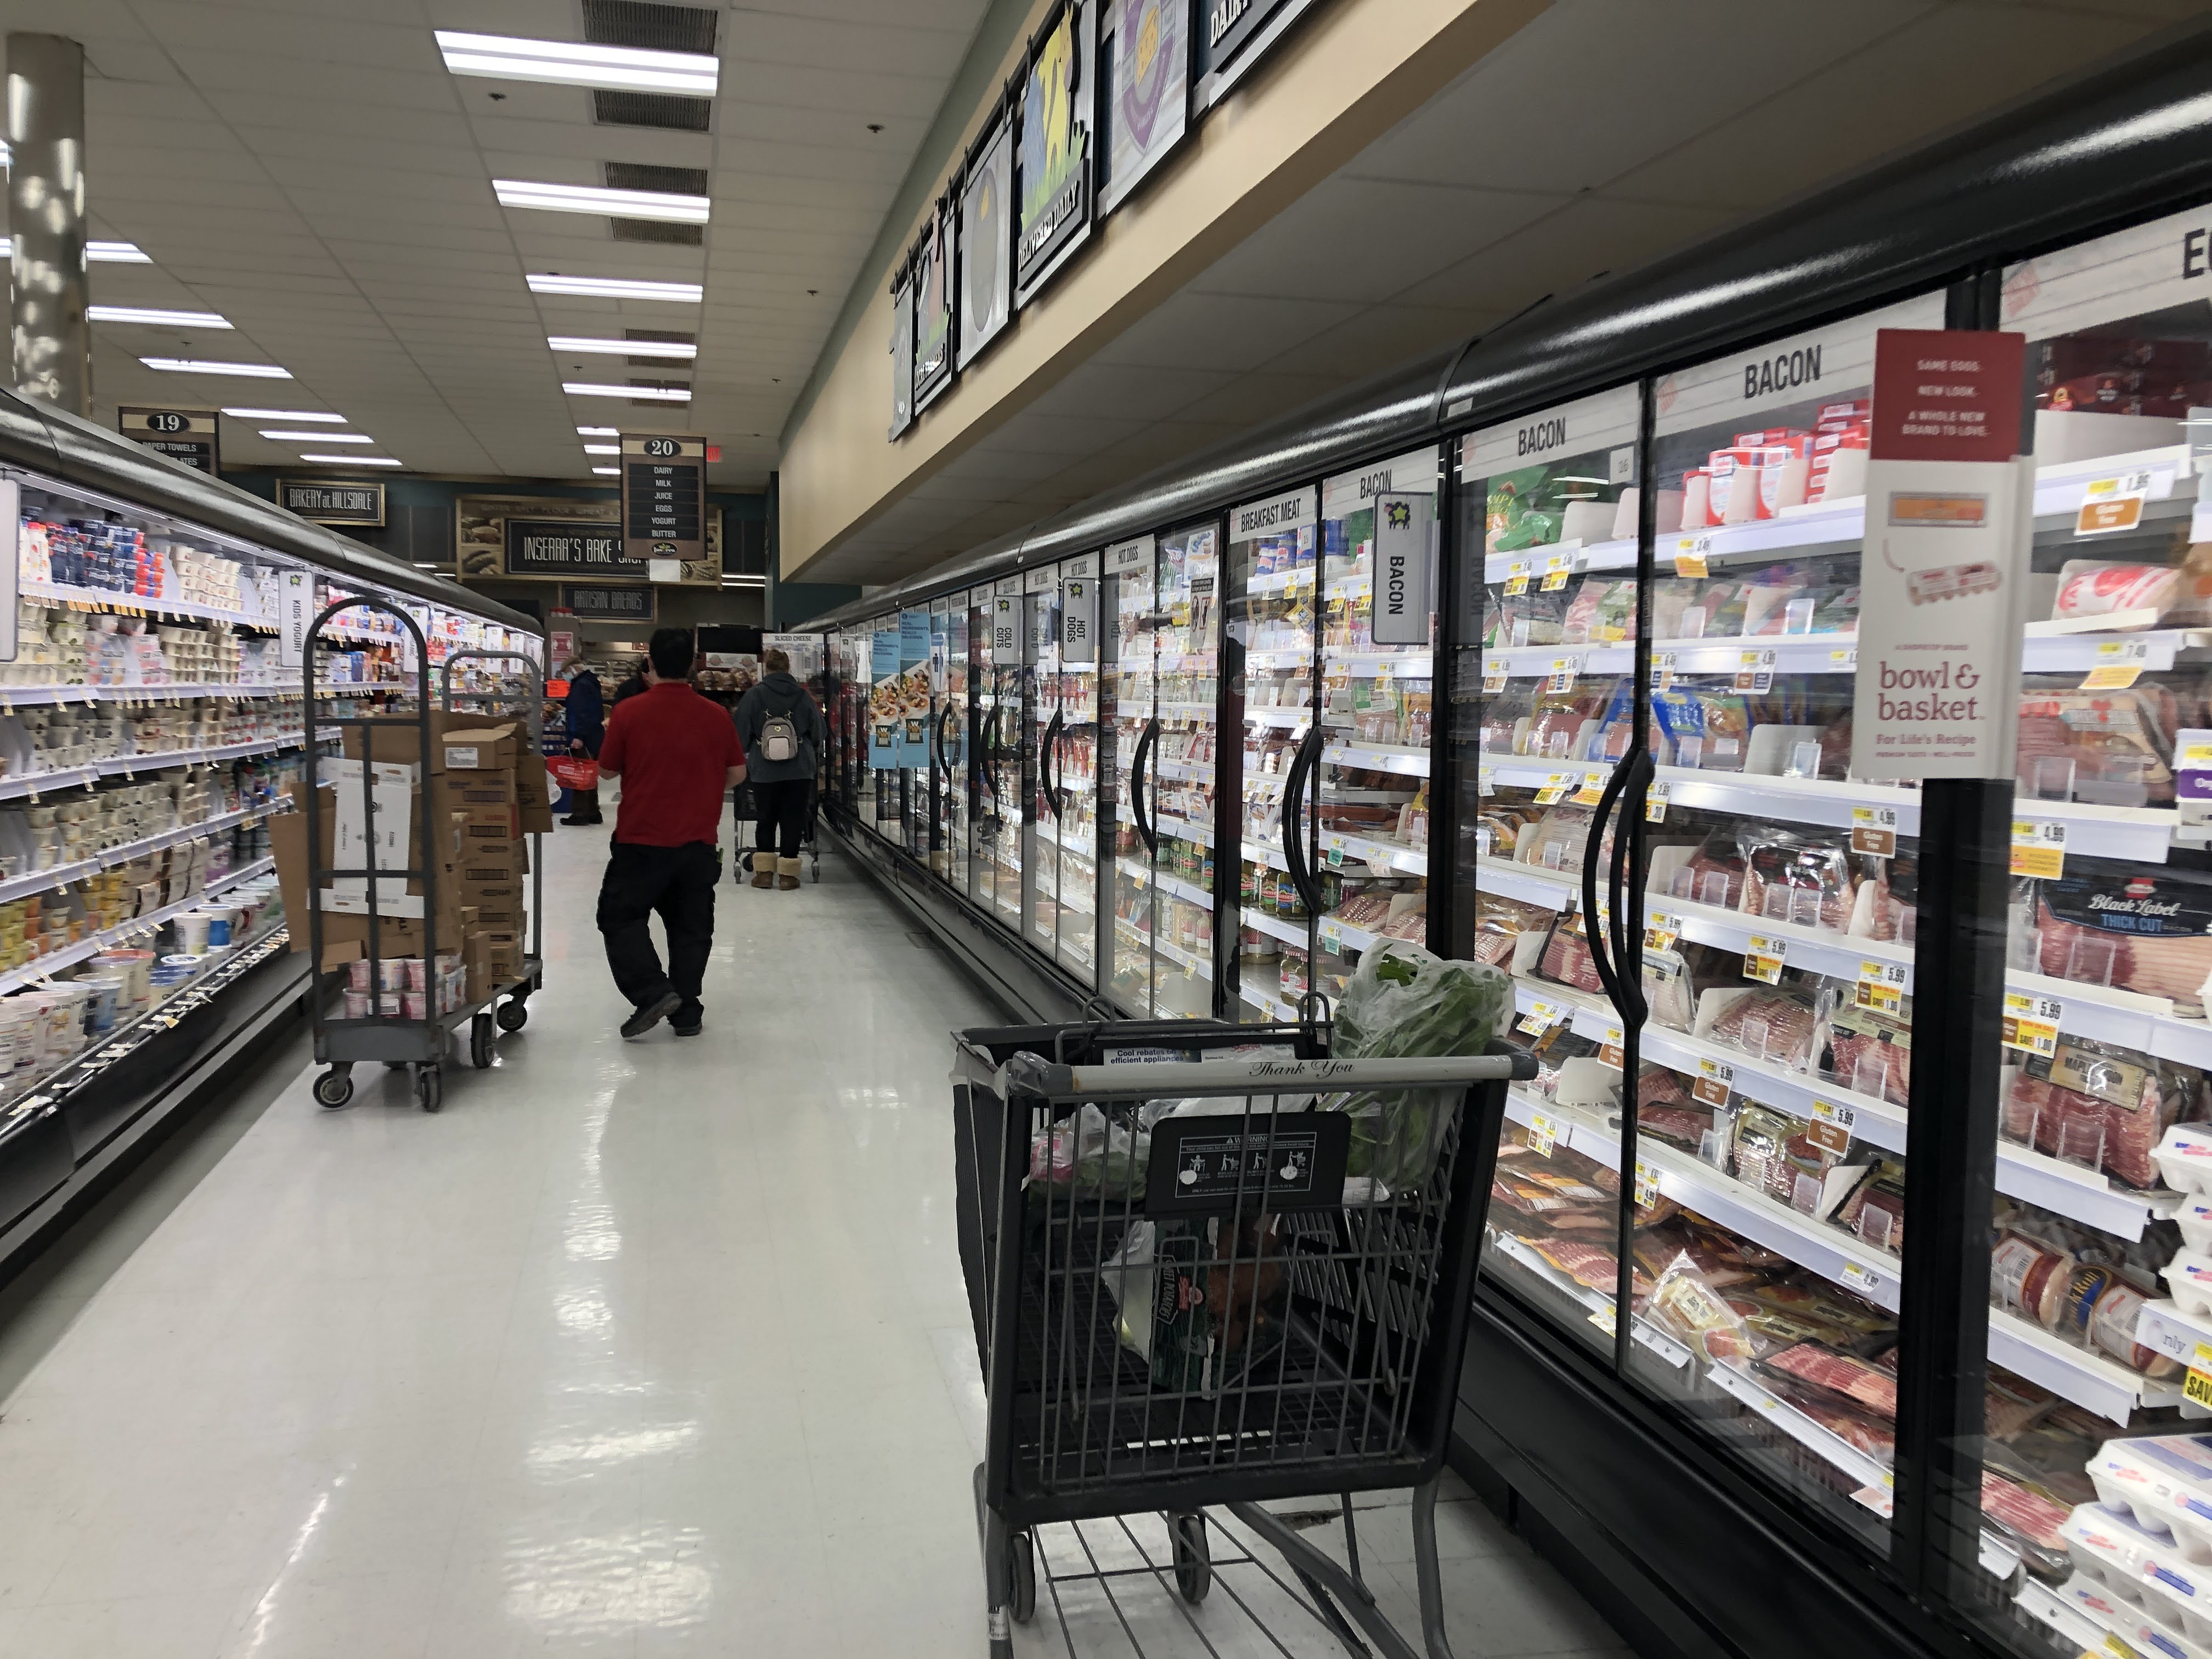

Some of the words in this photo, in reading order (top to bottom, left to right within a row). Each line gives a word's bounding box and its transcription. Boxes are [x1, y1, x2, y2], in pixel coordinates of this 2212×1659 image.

[1210, 0, 1249, 48] DAI
[1018, 211, 1054, 272] DELIVERED
[1054, 181, 1079, 230] DAILY
[1743, 345, 1821, 399] BACON
[1917, 359, 1948, 371] SAME
[1918, 385, 1943, 396] NEW
[156, 415, 180, 431] 19
[1908, 411, 1916, 420] A
[1919, 411, 1956, 421] WHOLE
[1959, 411, 1987, 422] NEW
[1518, 416, 1566, 456] BACON
[1901, 424, 1941, 435] BRAND
[1944, 425, 1957, 436] TO
[167, 443, 197, 452] TOWELS
[652, 439, 674, 455] 20
[1359, 469, 1392, 500] BACON
[290, 488, 322, 508] BAKERY
[323, 495, 331, 508] at
[332, 491, 372, 510] HILLSDALE
[1241, 504, 1280, 533] BREAKFAST
[1281, 498, 1301, 522] MEAT
[523, 537, 581, 562] INSERRA'S
[586, 539, 613, 563] BAKE
[1118, 549, 1126, 565] HOT
[1127, 545, 1138, 563] DOGS
[1078, 560, 1087, 575] DOGS
[1388, 555, 1406, 616] BACON
[574, 590, 608, 609] ARTISAN
[612, 591, 642, 610] BREADS
[292, 600, 302, 619] KIDS
[294, 622, 302, 653] YOGURT
[1067, 617, 1076, 642] DOGS
[1077, 620, 1086, 640] HOT
[1879, 661, 1950, 689] bowl
[1955, 663, 1980, 689] &
[1877, 692, 1978, 720] basket
[1876, 733, 1896, 744] For
[1900, 733, 1932, 744] Life's
[1936, 733, 1976, 747] Recipe
[1863, 831, 1883, 841] Gluten
[1866, 840, 1880, 850] Free
[2087, 893, 2135, 912] Black
[2135, 899, 2182, 917] Label
[2101, 913, 2137, 930] THICK
[2139, 917, 2163, 932] CUT
[1888, 967, 1905, 983] 5.99
[2040, 1001, 2061, 1019] 5.99
[1143, 1056, 1184, 1064] appliances
[1249, 1061, 1305, 1076] Thank
[1311, 1060, 1355, 1079] You
[1720, 1066, 1733, 1081] 5.99
[1705, 1082, 1719, 1093] Gluten
[1706, 1090, 1715, 1099] Free
[1838, 1109, 1854, 1126] 5.99
[1234, 1135, 1271, 1144] WRNING
[1820, 1125, 1838, 1138] Gluten
[1821, 1135, 1833, 1146] Free
[2187, 1375, 2212, 1405] SAV
